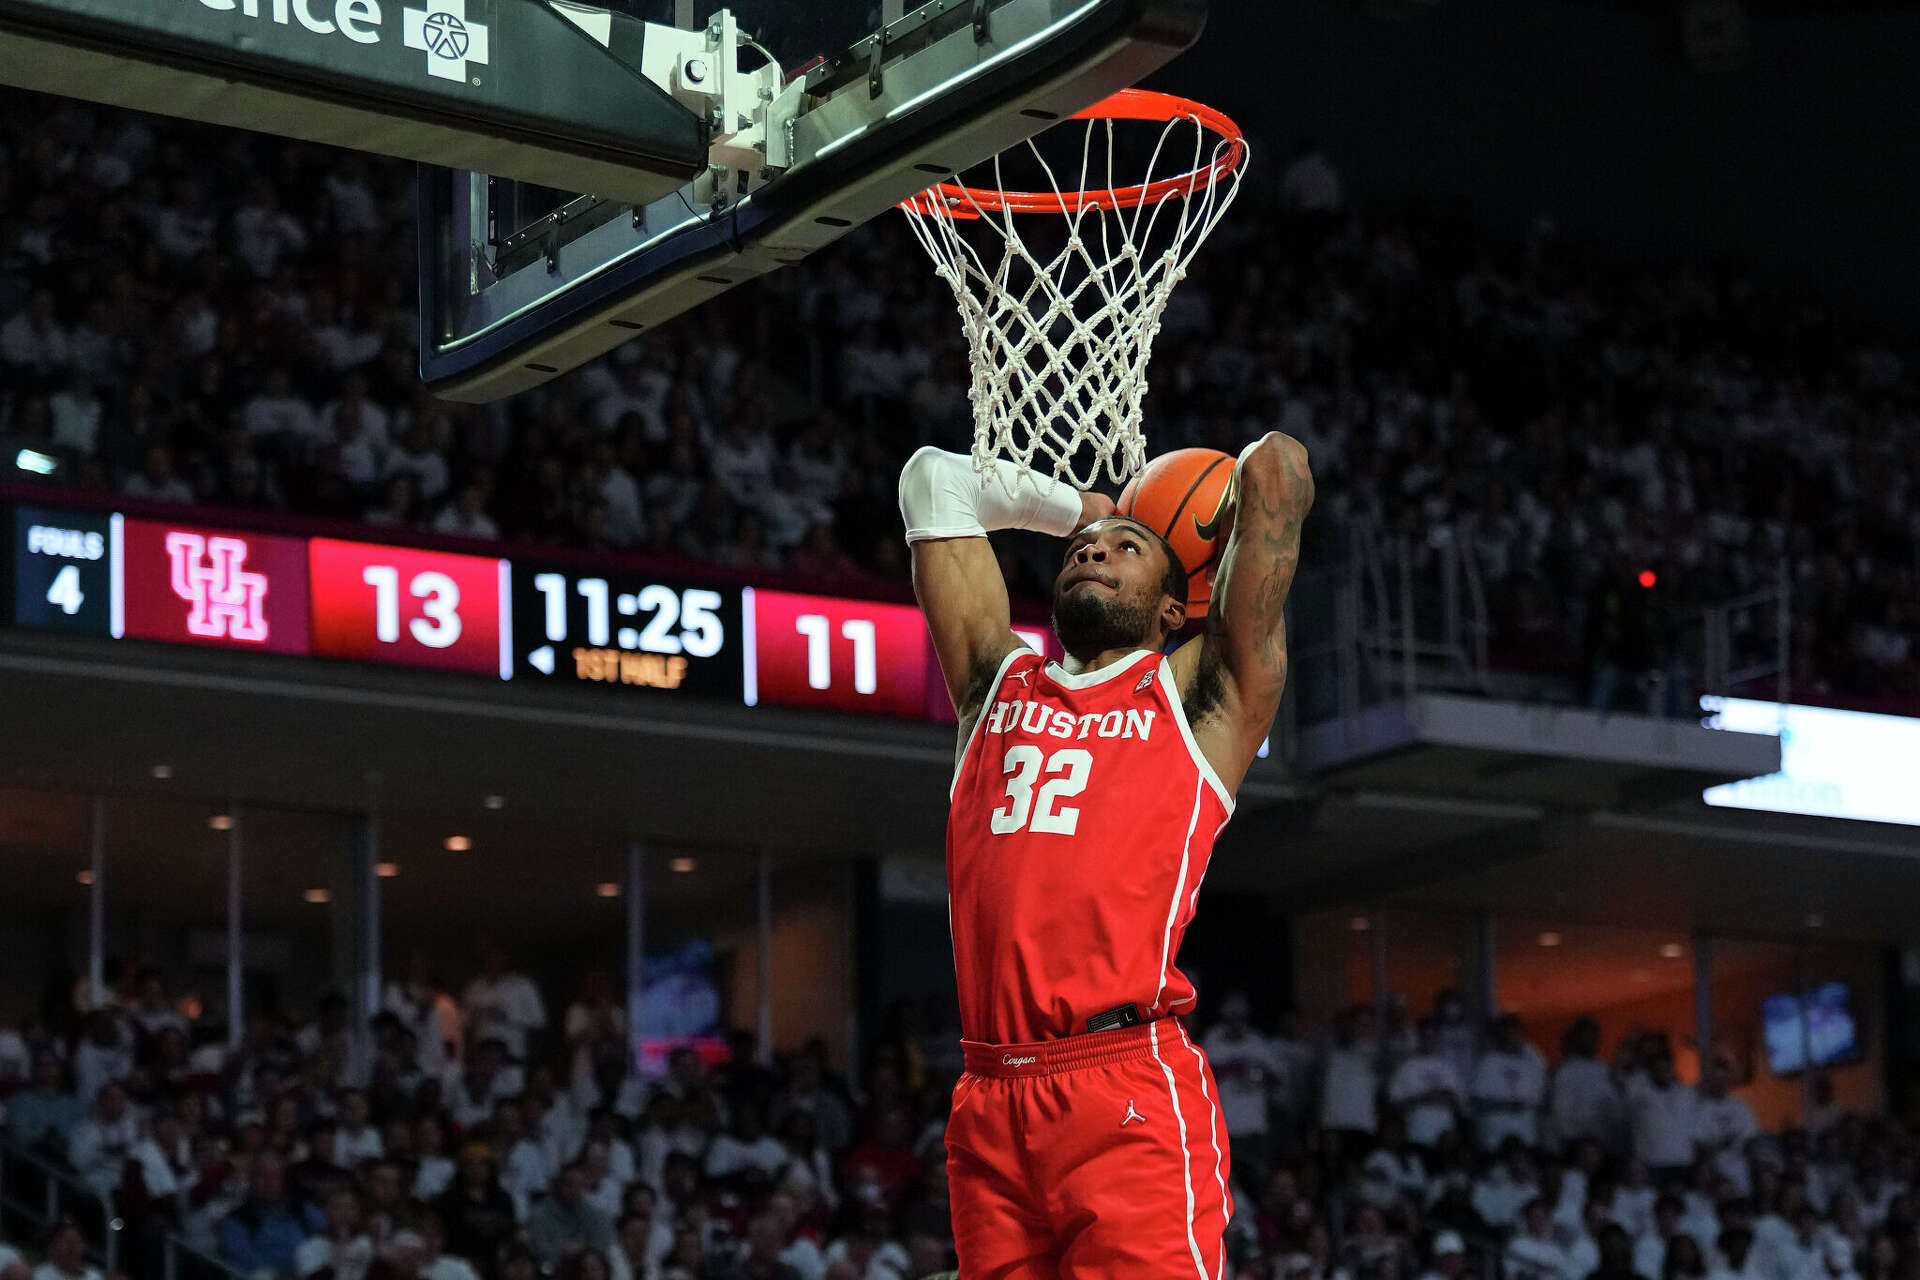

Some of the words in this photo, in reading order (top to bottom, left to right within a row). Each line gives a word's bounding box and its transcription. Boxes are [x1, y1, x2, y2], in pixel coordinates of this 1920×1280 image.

[200, 0, 382, 44] ce
[46, 565, 85, 615] 4
[363, 565, 462, 648] 13
[534, 573, 724, 657] 11:25
[796, 614, 877, 694] 11
[985, 700, 1155, 741] HOUSTON
[990, 745, 1093, 836] 32
[1002, 1053, 1036, 1068] Cougars
